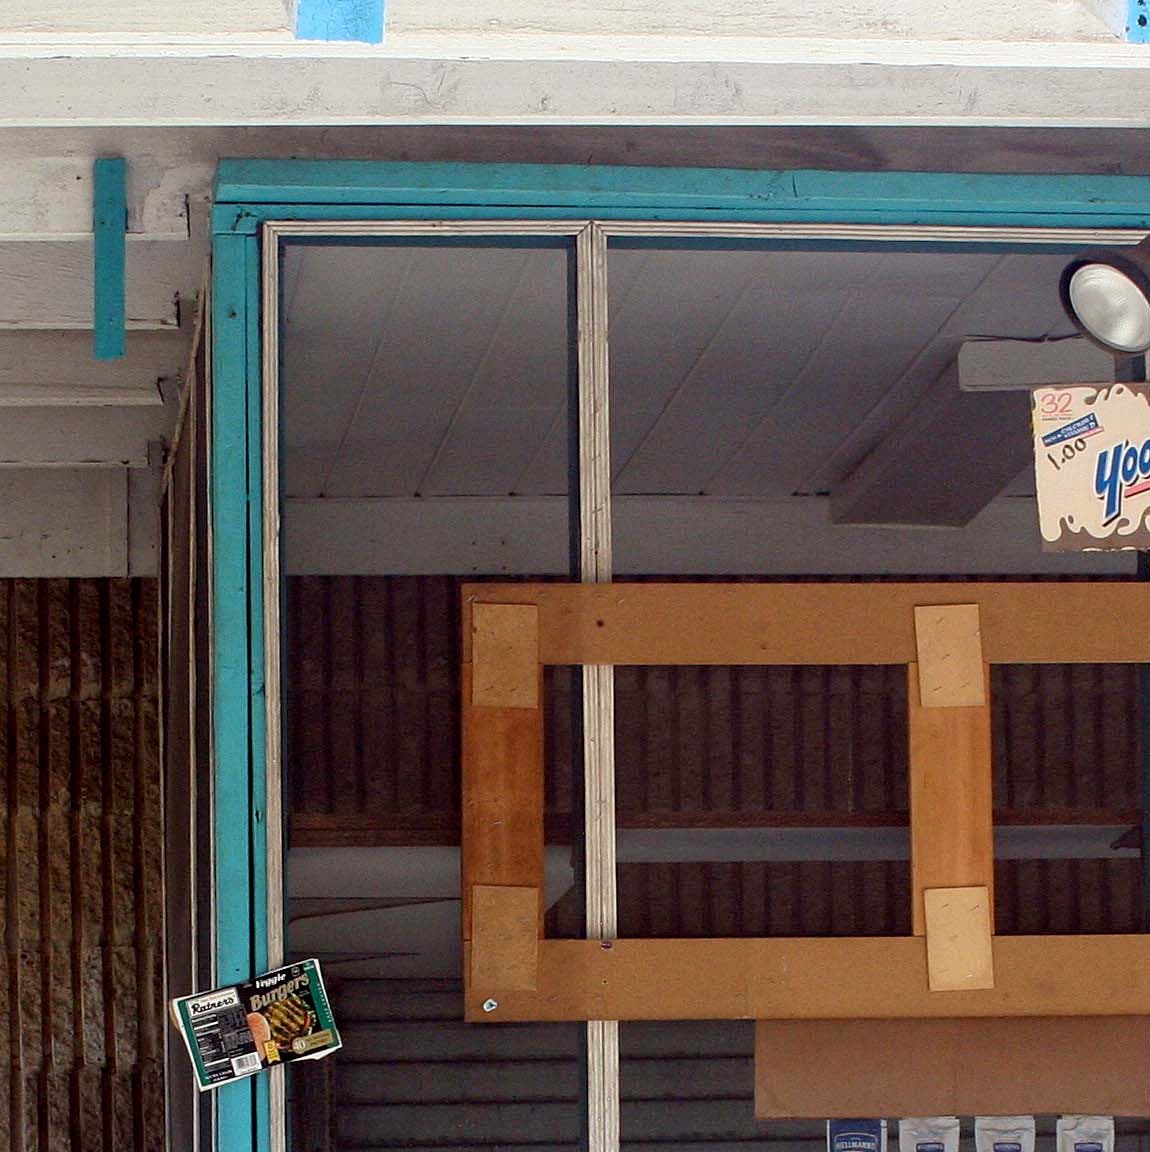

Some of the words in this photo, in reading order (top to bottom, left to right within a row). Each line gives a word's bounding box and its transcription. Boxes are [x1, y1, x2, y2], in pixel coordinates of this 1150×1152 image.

[1041, 392, 1072, 414] 32
[1047, 438, 1087, 470] 1.00
[249, 973, 310, 1012] Burgers
